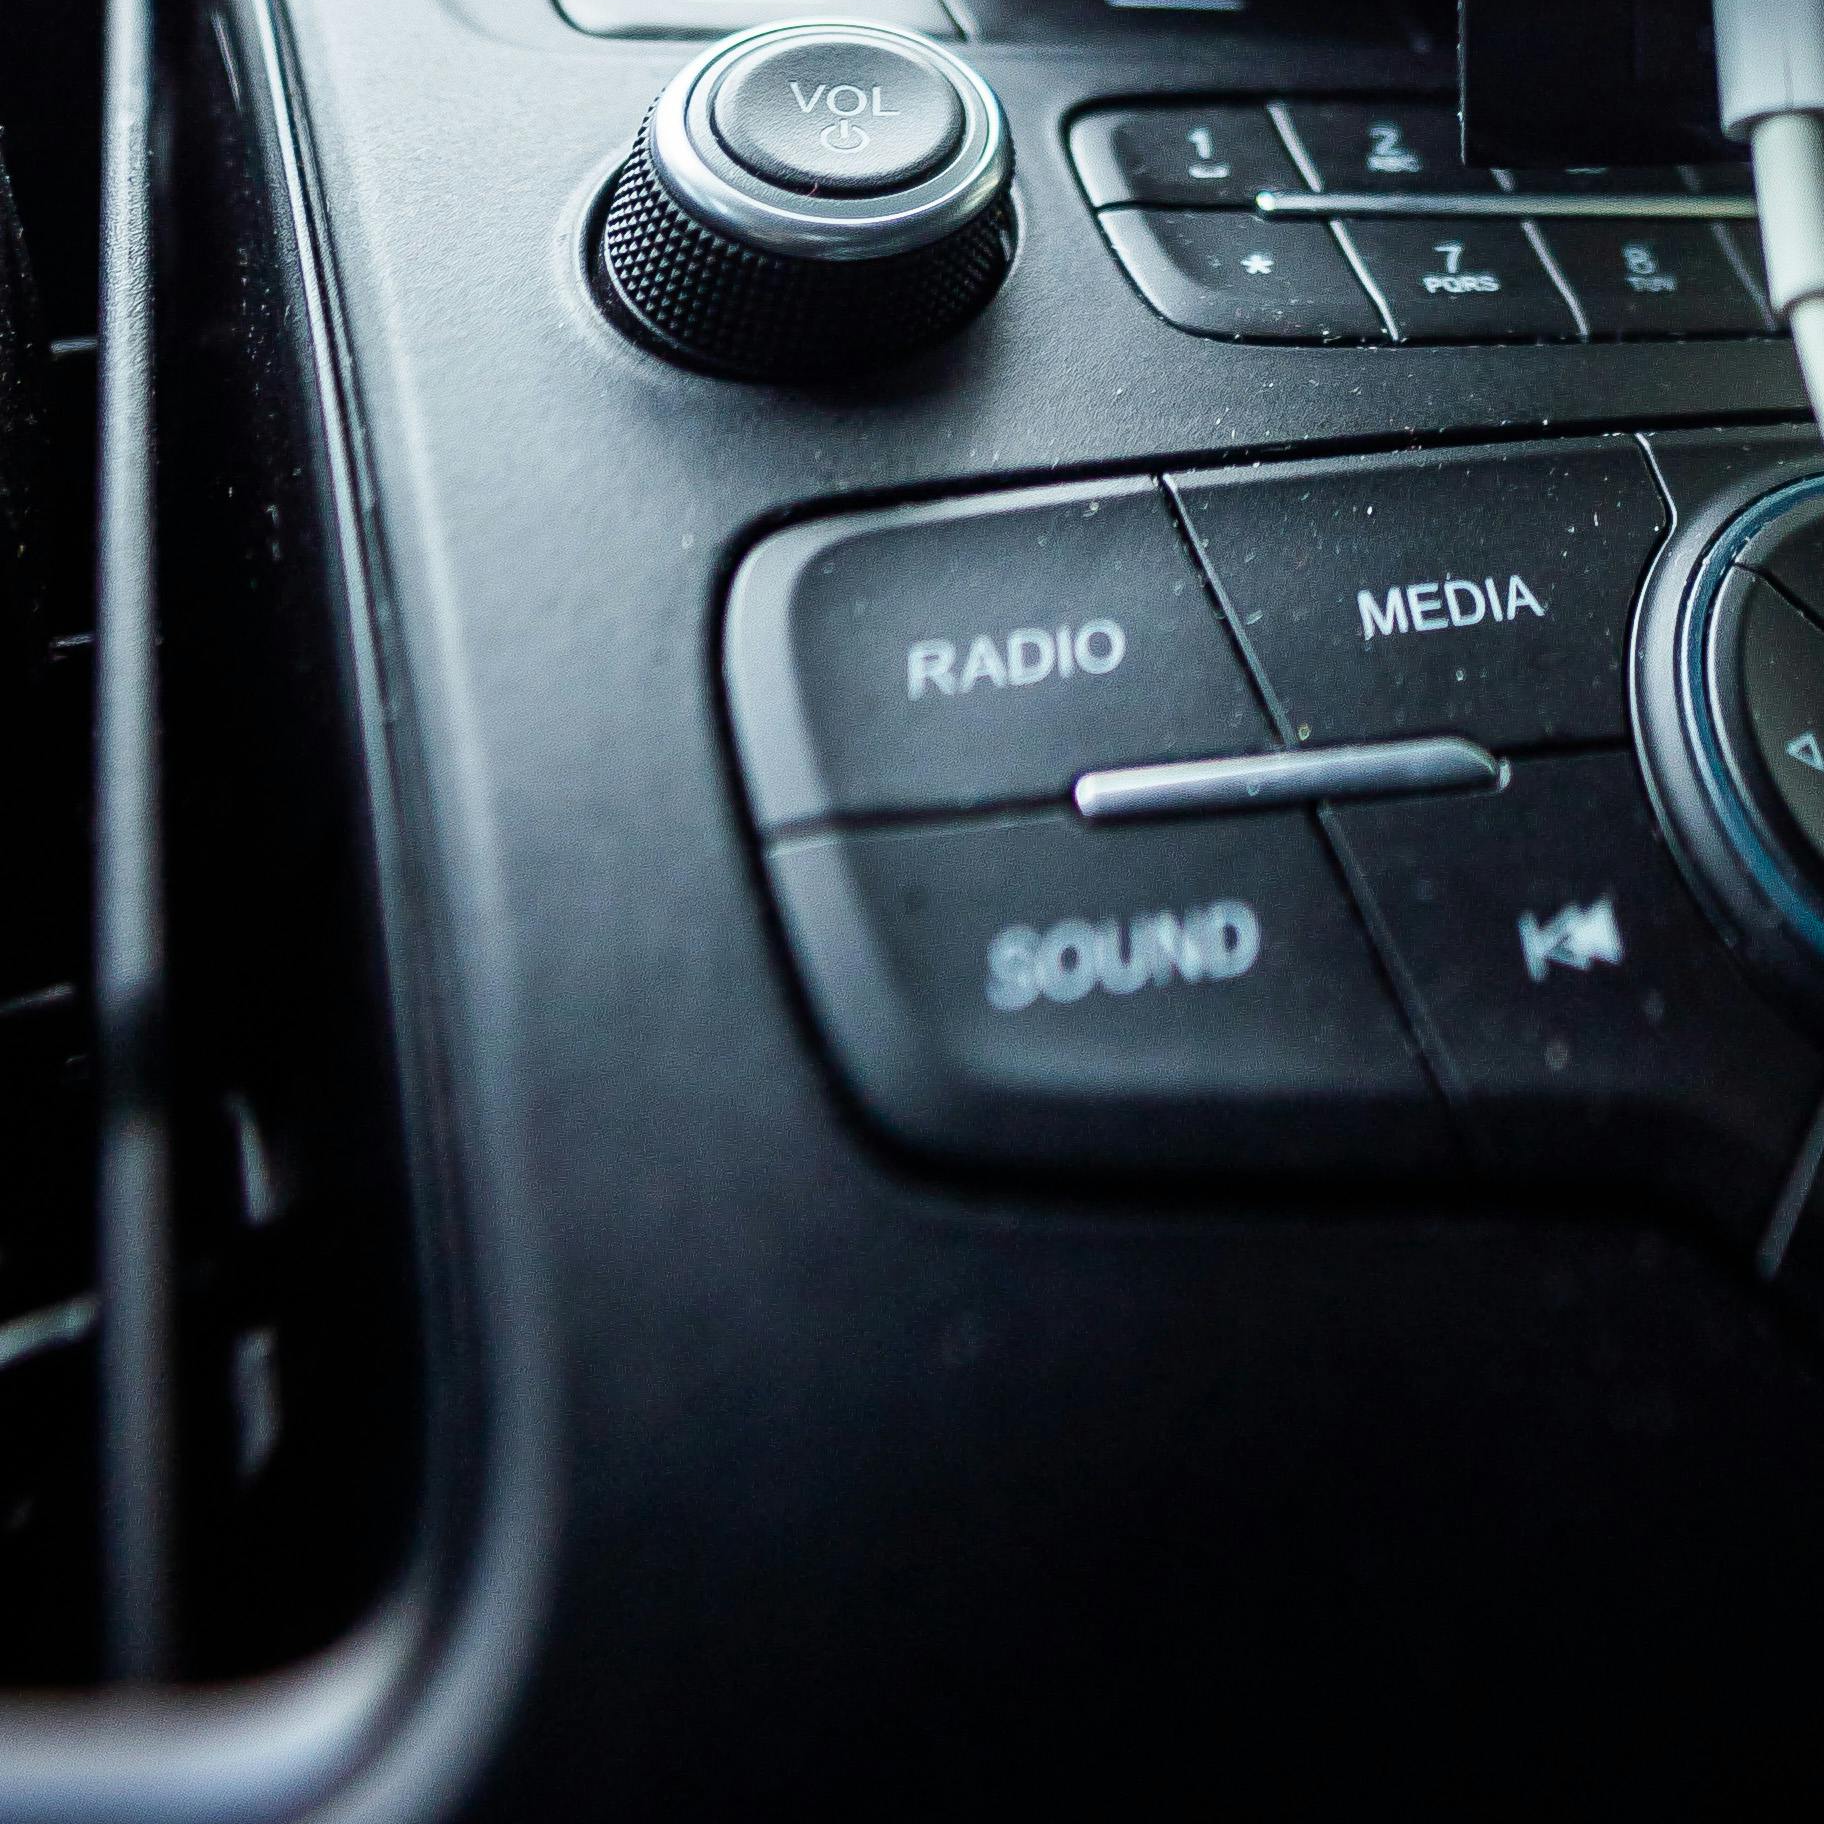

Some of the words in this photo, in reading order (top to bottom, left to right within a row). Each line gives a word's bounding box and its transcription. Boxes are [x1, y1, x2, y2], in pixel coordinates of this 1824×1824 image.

[788, 80, 902, 119] VOL
[1187, 126, 1216, 159] 1
[1432, 241, 1464, 273] 7
[1421, 272, 1501, 294] PQRS
[1356, 573, 1546, 641] MEDIA
[905, 618, 1128, 702] RADIO
[985, 899, 1263, 1013] SOUND
